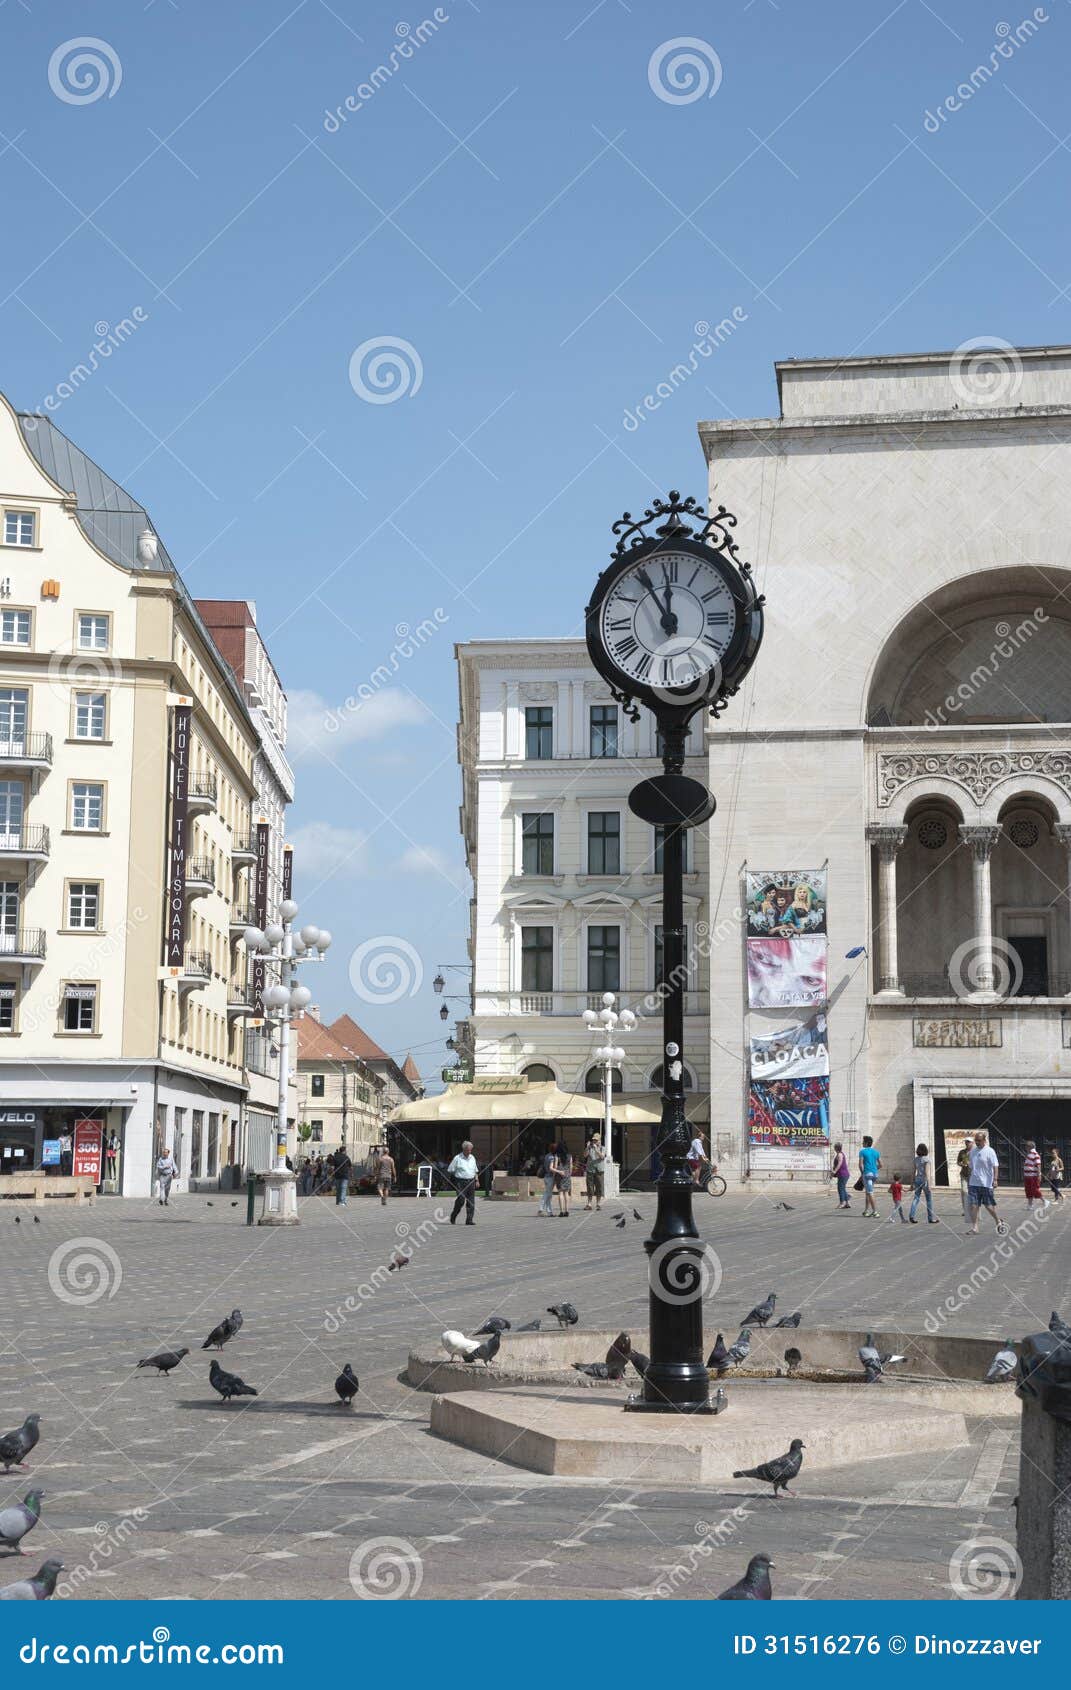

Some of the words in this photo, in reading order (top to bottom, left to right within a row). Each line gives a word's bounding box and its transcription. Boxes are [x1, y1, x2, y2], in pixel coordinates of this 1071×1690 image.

[177, 717, 187, 800] HOTEL
[258, 831, 266, 895] HOTEL
[751, 1043, 829, 1065] CLOACA
[752, 1126, 770, 1135] BAD
[772, 1127, 790, 1135] BED
[791, 1127, 827, 1136] STORIES
